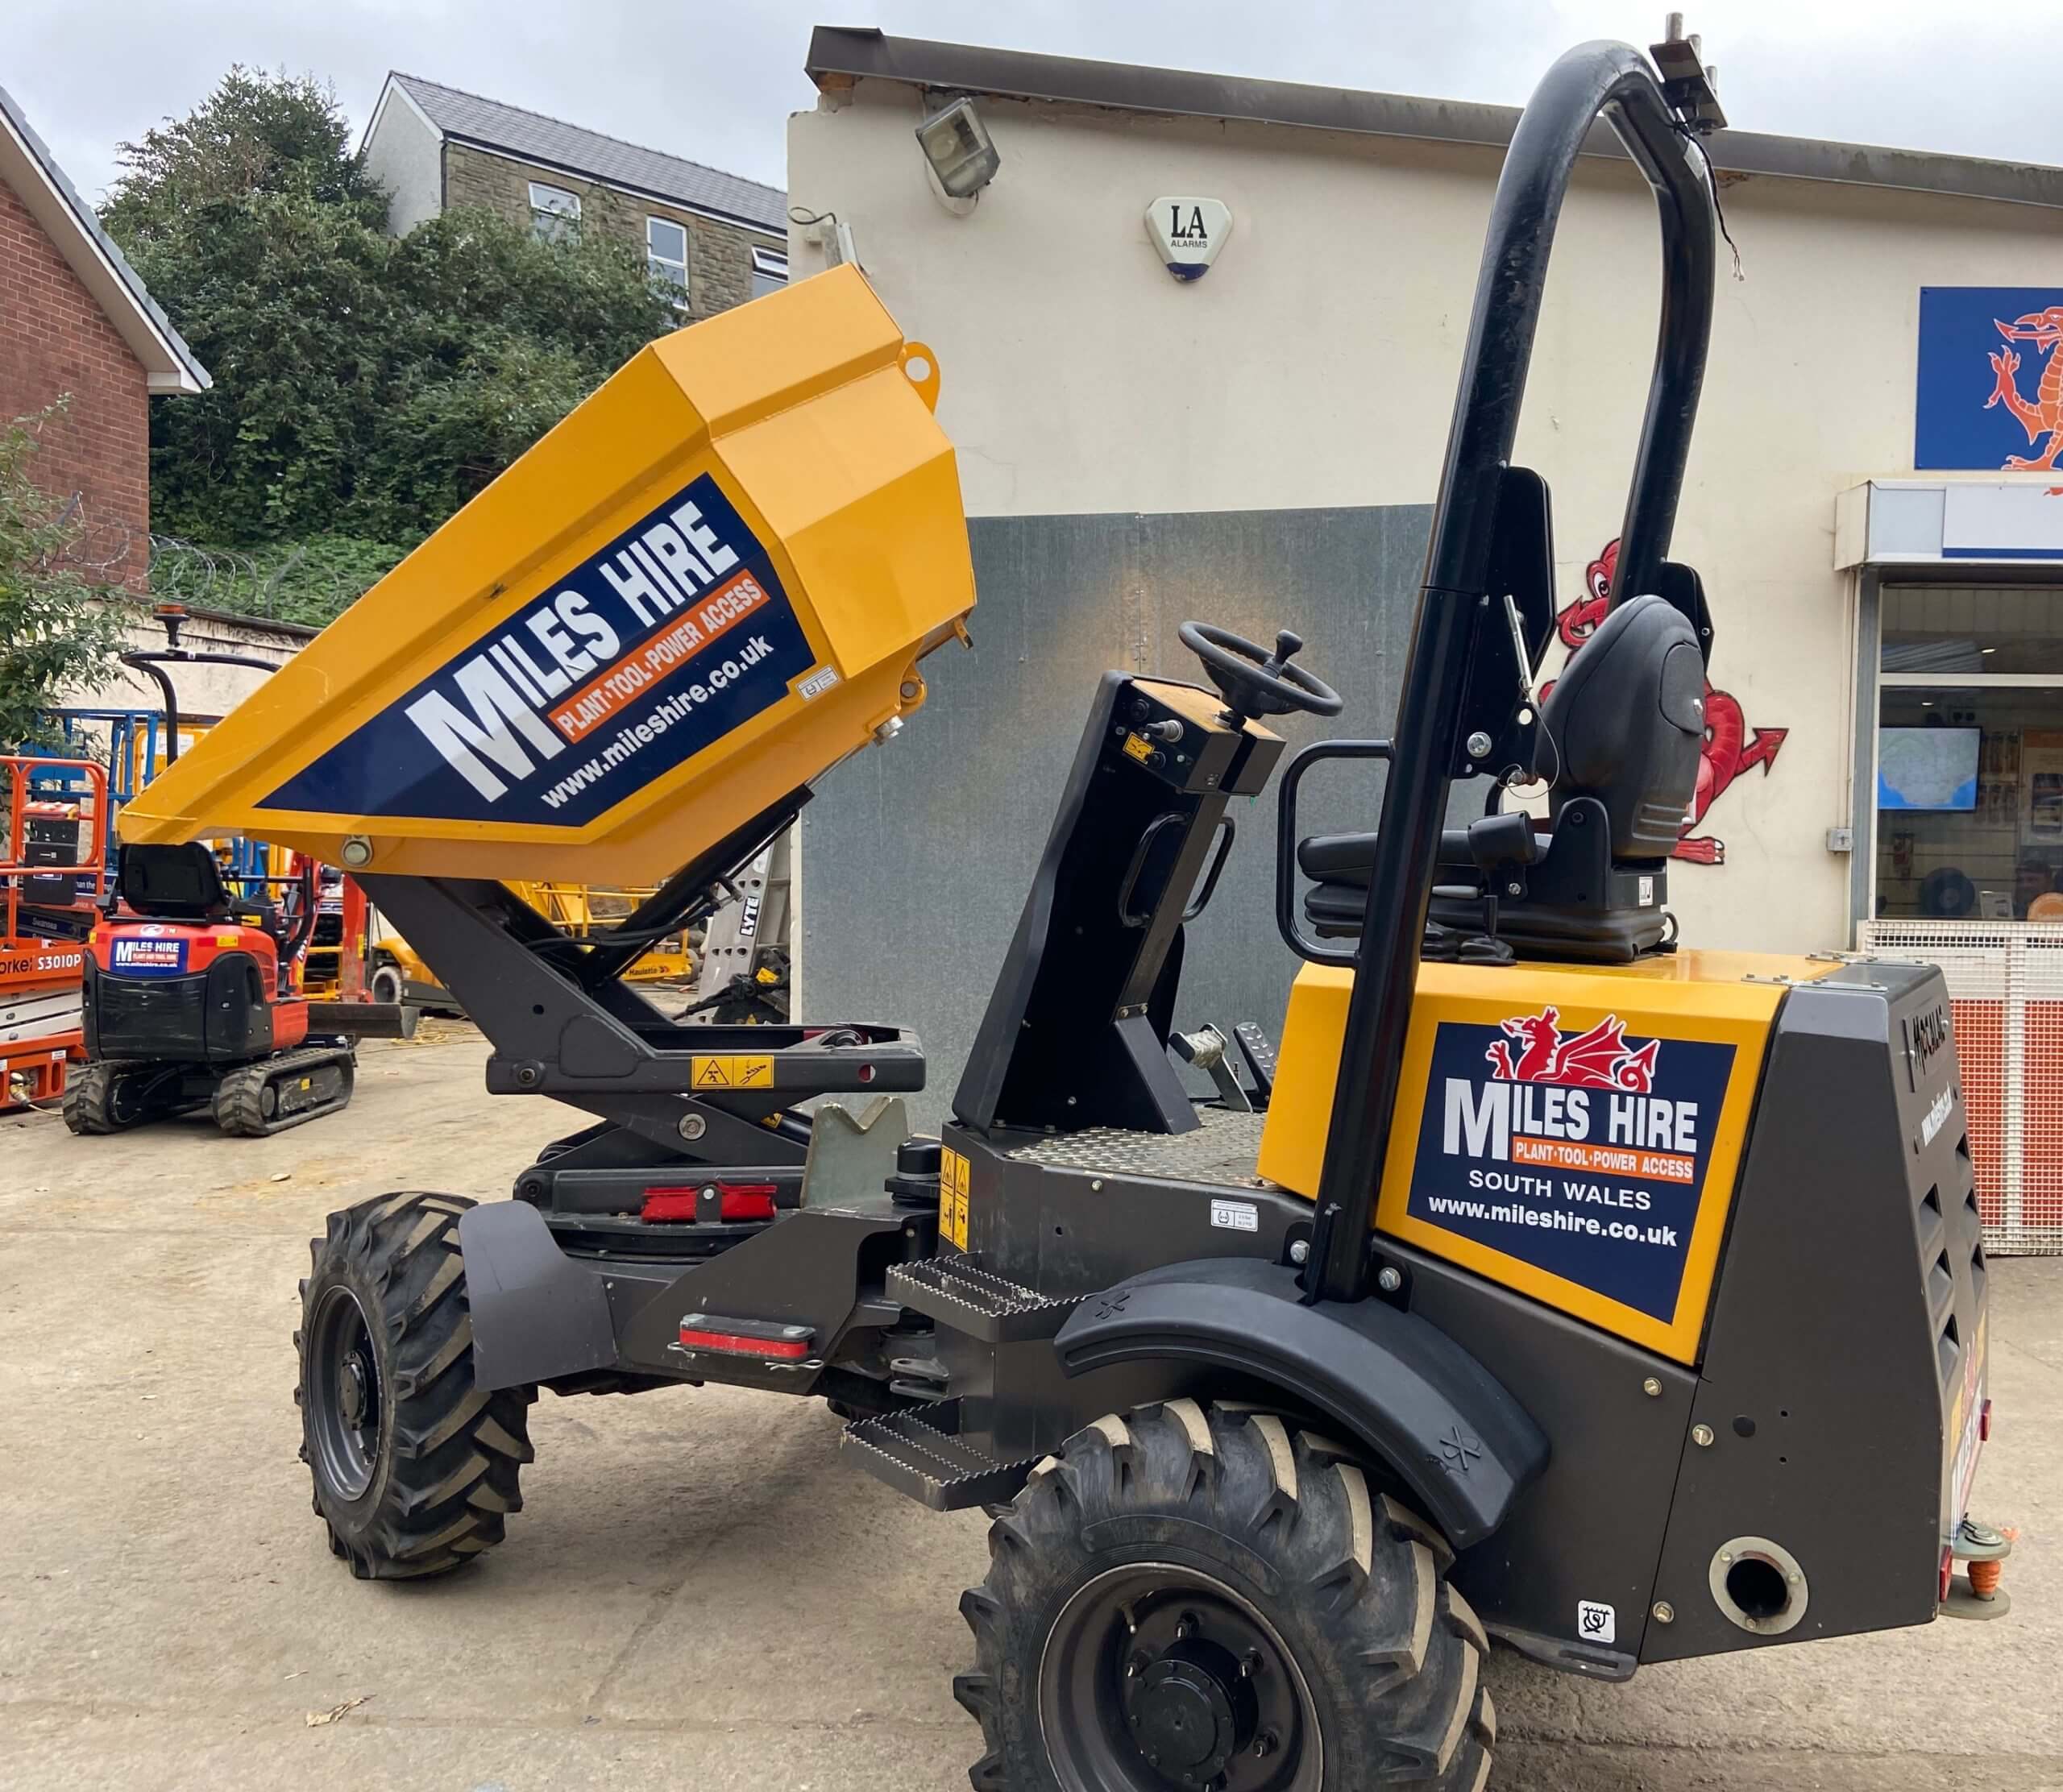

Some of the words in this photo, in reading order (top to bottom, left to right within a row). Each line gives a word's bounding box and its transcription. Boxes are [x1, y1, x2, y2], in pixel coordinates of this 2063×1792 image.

[1171, 205, 1207, 239] LA
[1170, 240, 1207, 248] ALARMS
[699, 579, 762, 633] ACCESS
[405, 590, 621, 803] MILES
[599, 500, 740, 628] HIRE
[541, 634, 774, 808] www.mileshire.co.uk
[37, 954, 81, 970] S3010P
[116, 941, 153, 962] MILES
[155, 943, 180, 952] HIRE
[1443, 1077, 1590, 1160] MILES
[1608, 1094, 1698, 1153] HIRE
[1642, 1156, 1693, 1179] ACCESS
[1469, 1169, 1552, 1197] SOUTH
[1563, 1181, 1651, 1210] WALES
[1429, 1197, 1677, 1247] www.mileshire.co.uk
